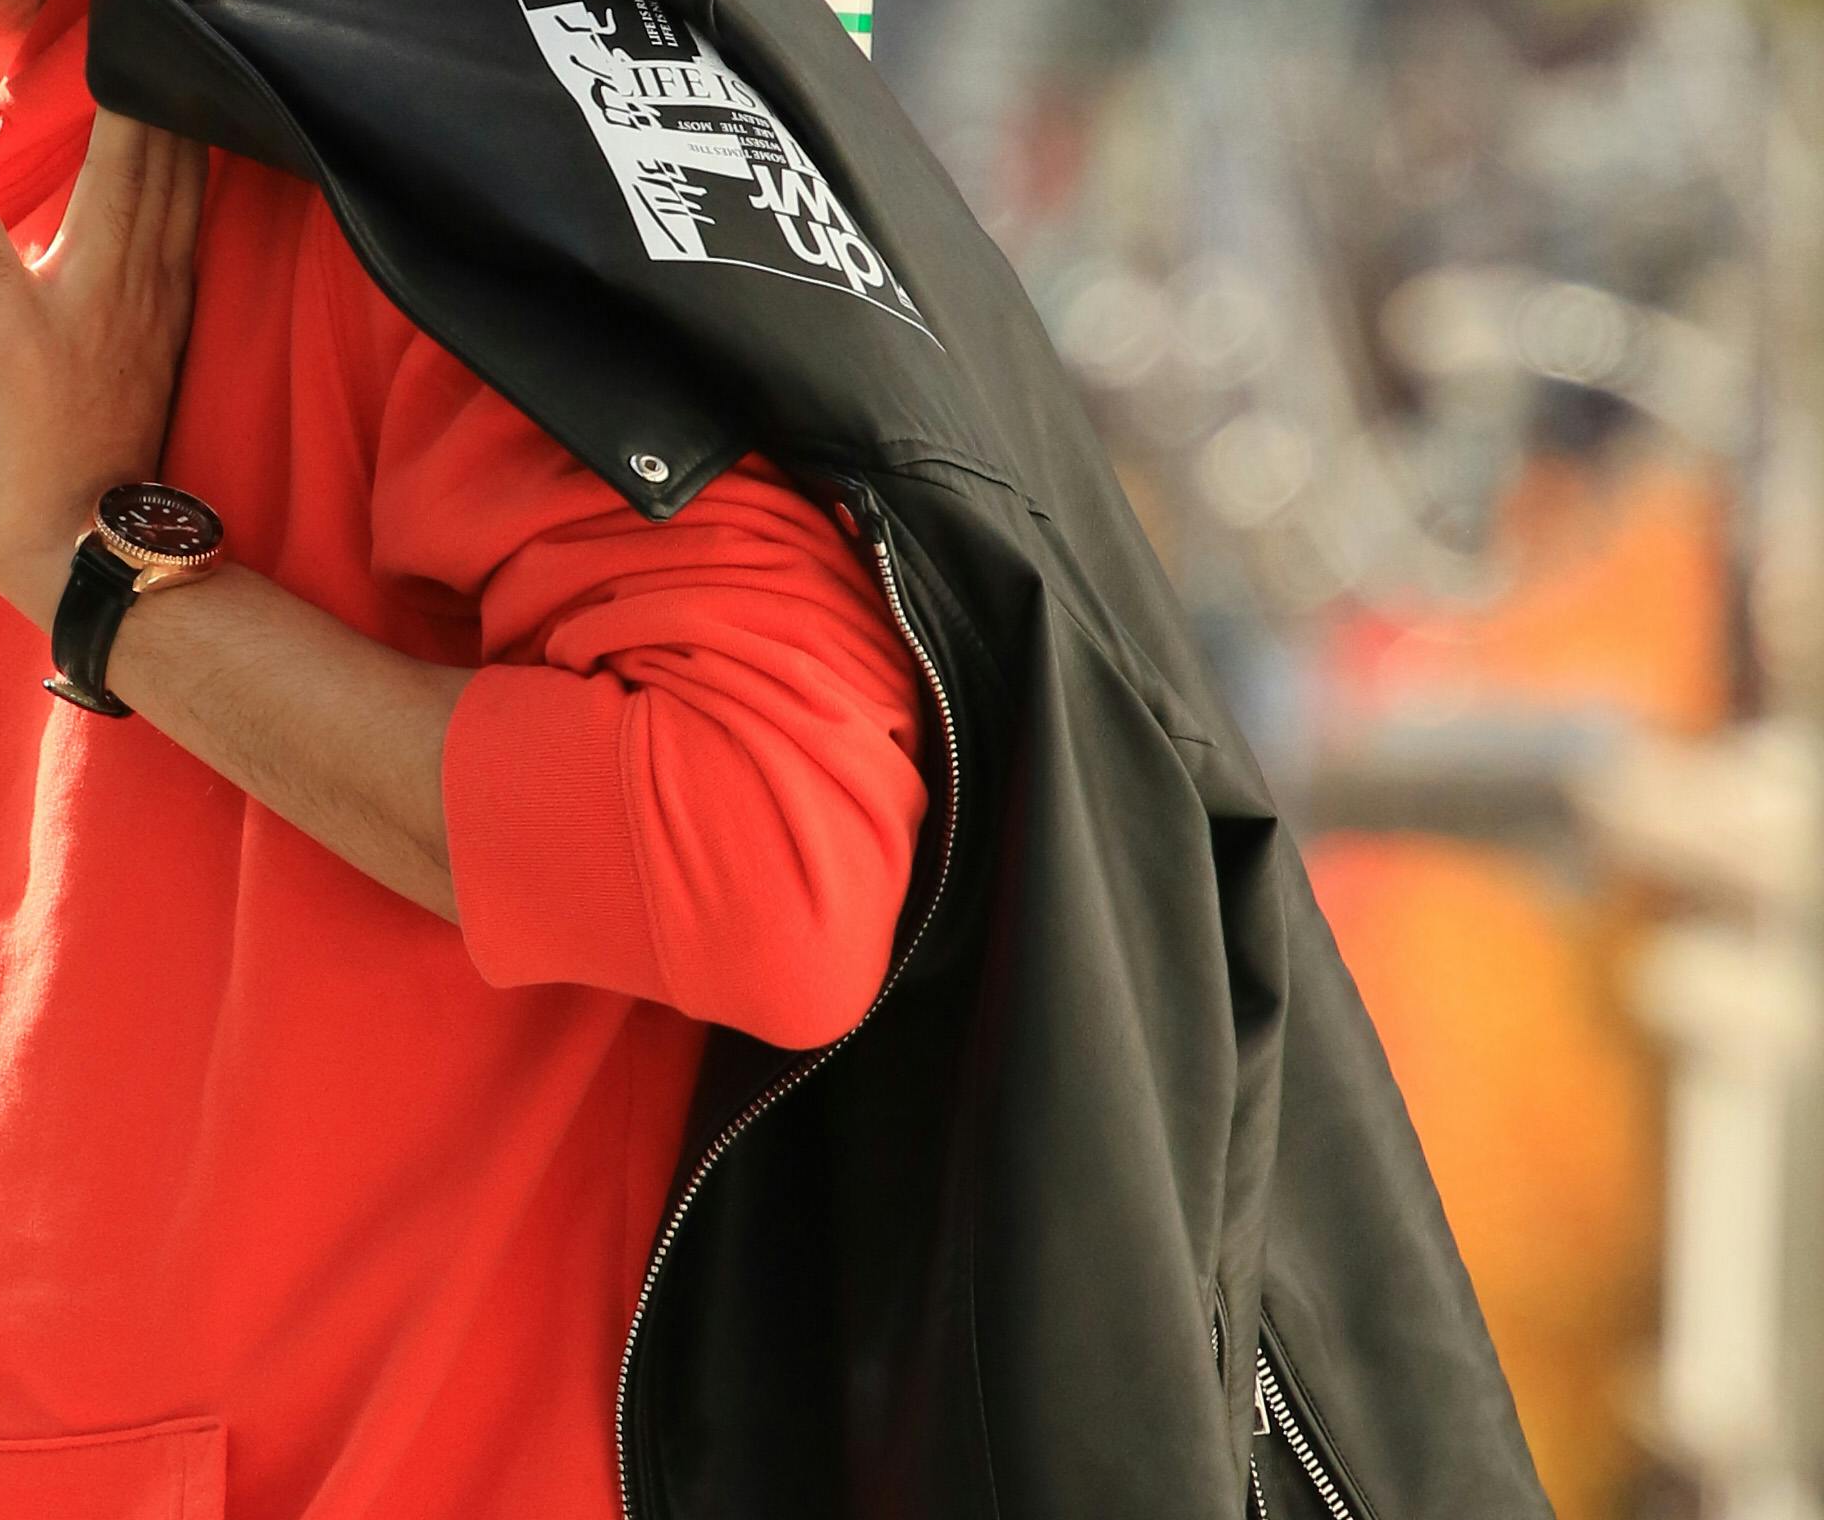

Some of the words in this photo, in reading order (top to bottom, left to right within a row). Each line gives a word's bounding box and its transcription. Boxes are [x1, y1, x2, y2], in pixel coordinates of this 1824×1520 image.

[638, 10, 653, 21] IS
[654, 13, 668, 23] IS
[643, 21, 663, 46] LIFE
[659, 23, 679, 47] LIFE
[621, 67, 711, 97] IFE
[713, 73, 756, 108] IS
[677, 120, 713, 131] MOST
[720, 122, 748, 134] THE
[739, 136, 782, 152] WISEST
